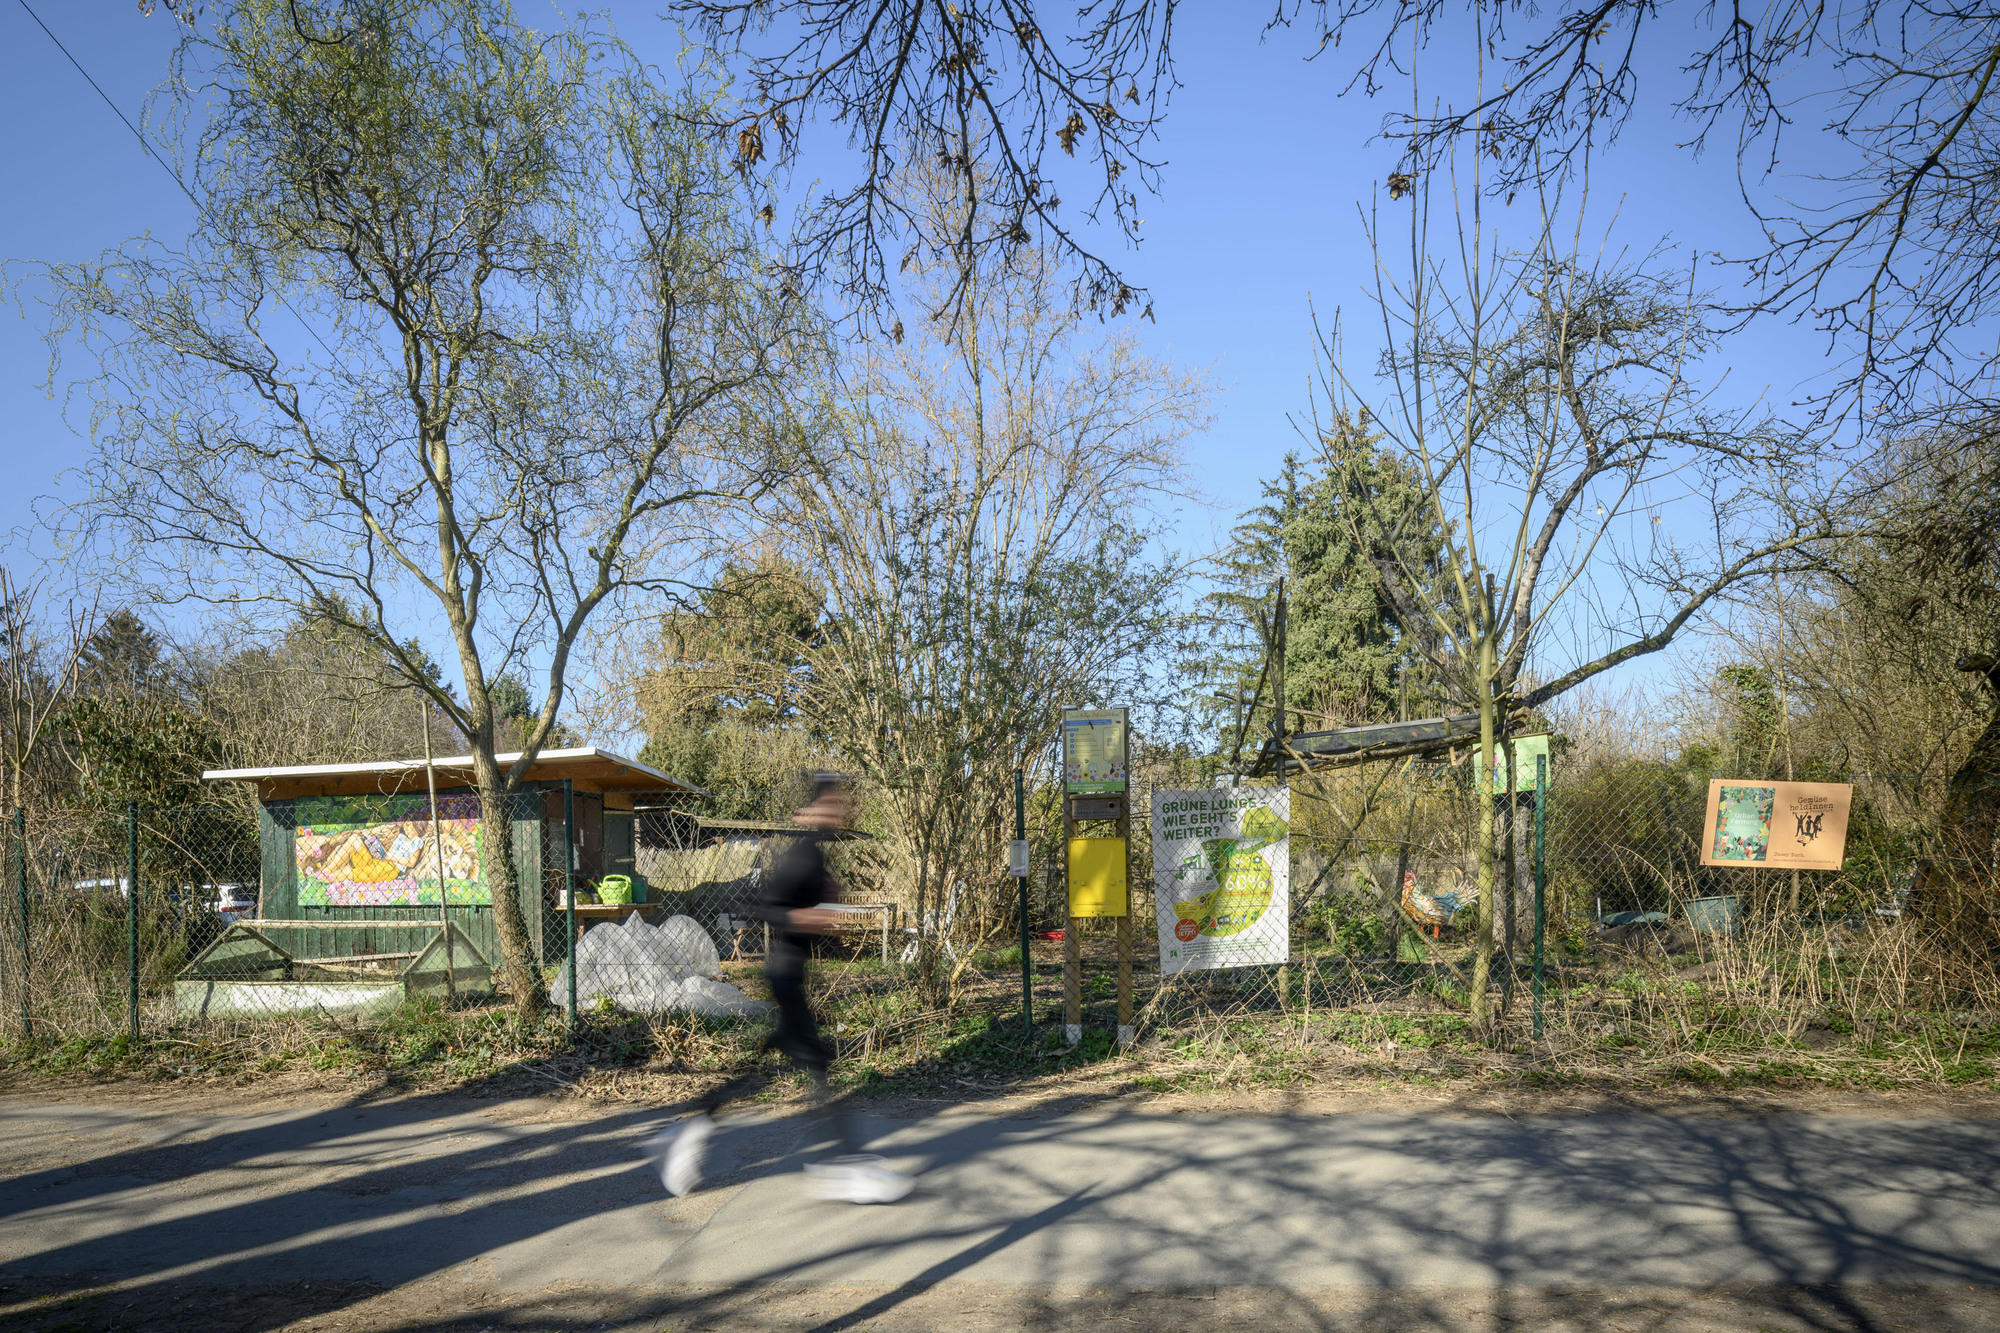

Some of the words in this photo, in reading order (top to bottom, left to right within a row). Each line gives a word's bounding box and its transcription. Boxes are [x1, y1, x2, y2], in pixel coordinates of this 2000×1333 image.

[1162, 798, 1208, 814] GRÜNE
[1211, 798, 1257, 811] LUNGE
[1798, 796, 1828, 804] Gemüse
[1163, 814, 1187, 828] WIE
[1730, 818, 1759, 826] Farming
[1163, 825, 1220, 841] WEITER?
[1225, 874, 1265, 891] 60%
